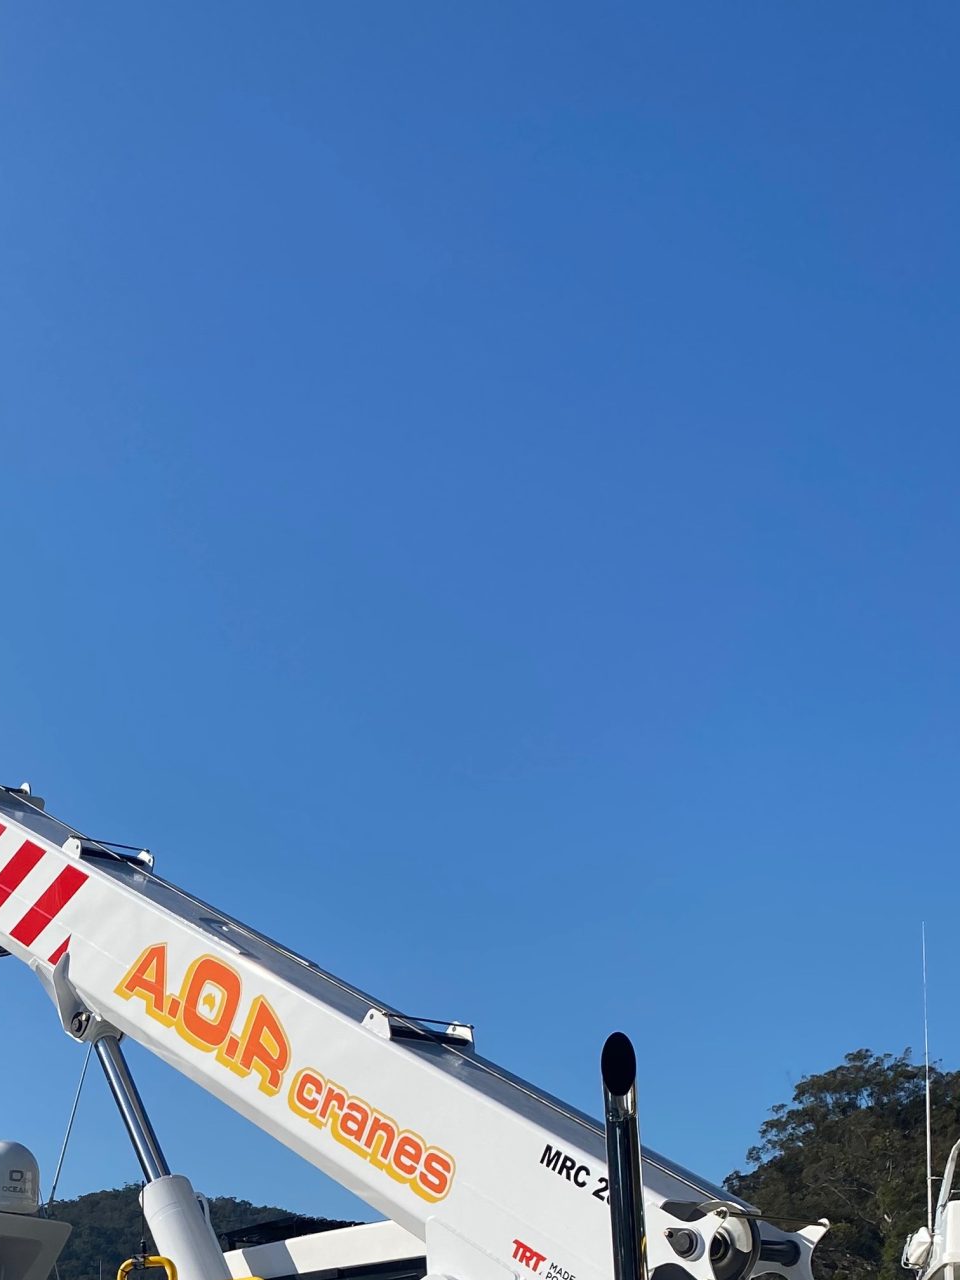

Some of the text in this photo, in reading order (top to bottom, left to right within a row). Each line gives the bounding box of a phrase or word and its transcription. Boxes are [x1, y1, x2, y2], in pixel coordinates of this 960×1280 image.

[113, 942, 456, 1204] A.O.R cranes
[539, 1144, 611, 1206] MRC 2
[512, 1239, 548, 1273] TRT
